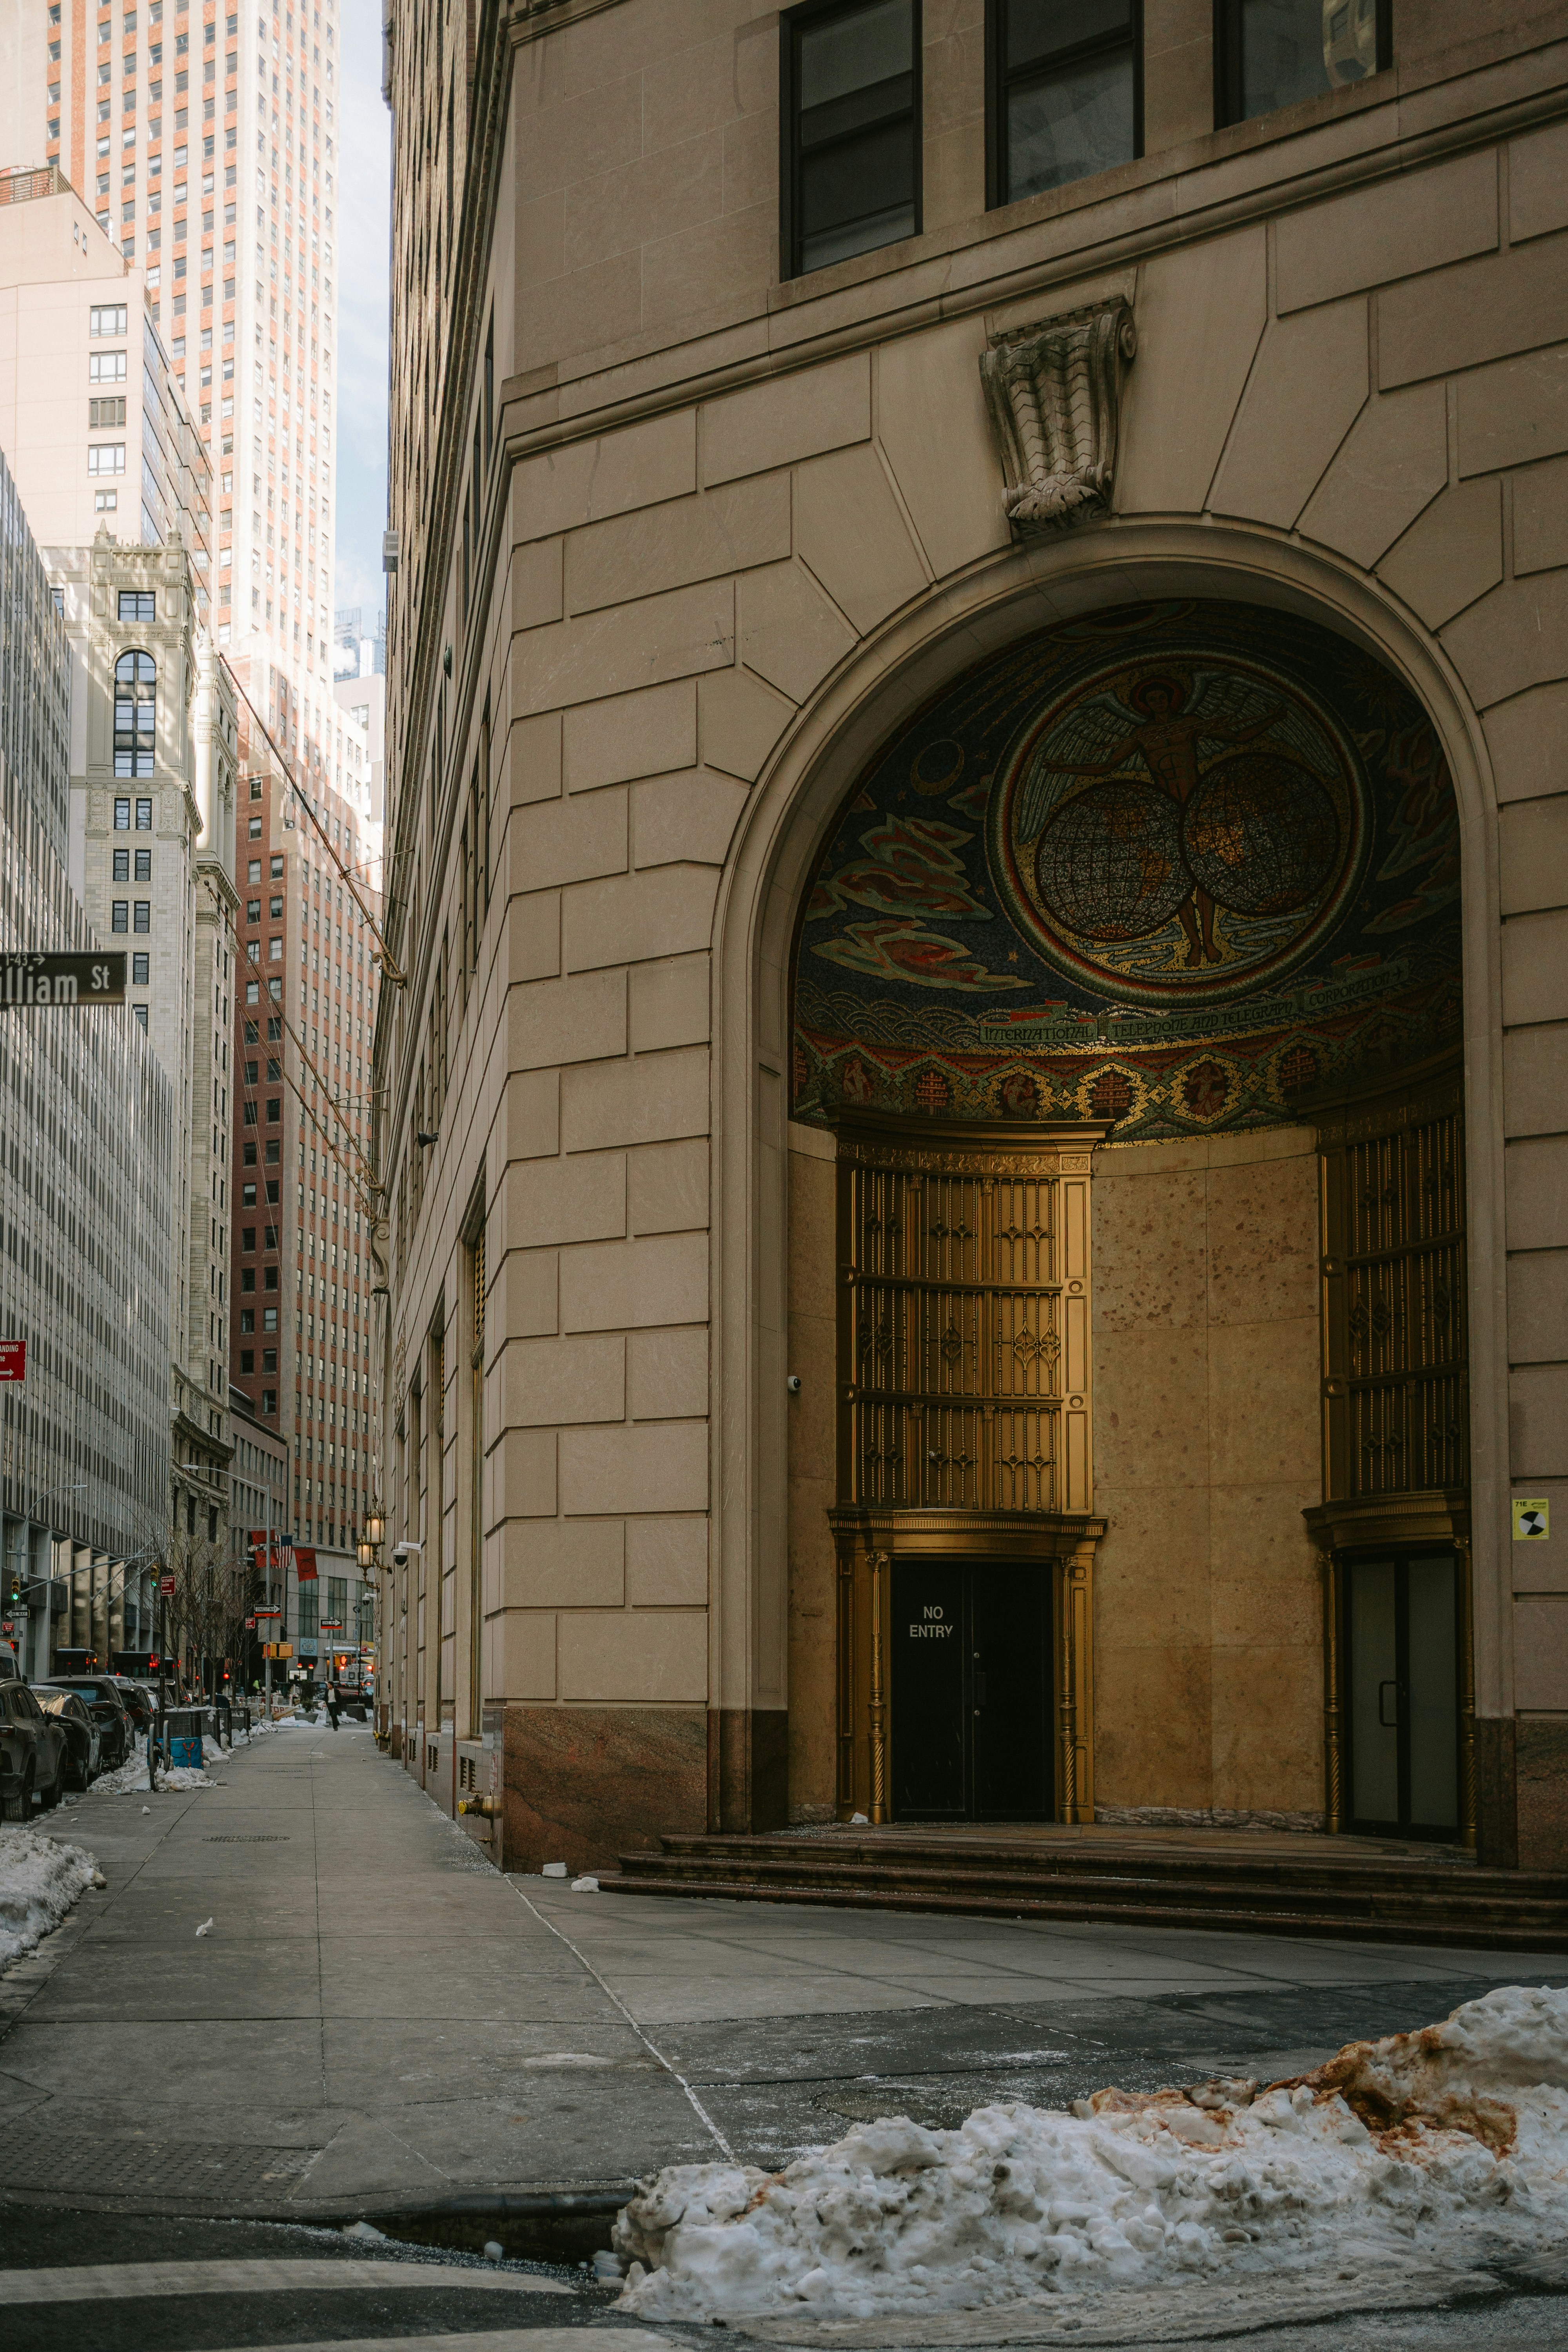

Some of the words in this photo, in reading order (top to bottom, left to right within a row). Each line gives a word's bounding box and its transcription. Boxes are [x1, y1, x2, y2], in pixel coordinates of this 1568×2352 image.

[91, 965, 110, 989] St
[985, 1026, 1094, 1041] INTERNATIONAL
[1112, 1017, 1187, 1038] TELEPHONE
[1192, 1014, 1219, 1029] AND
[1221, 1002, 1293, 1025] TELEGRAPH
[1309, 971, 1390, 1006] CORPORATION
[924, 1606, 943, 1619] NO
[909, 1624, 953, 1637] ENTRY
